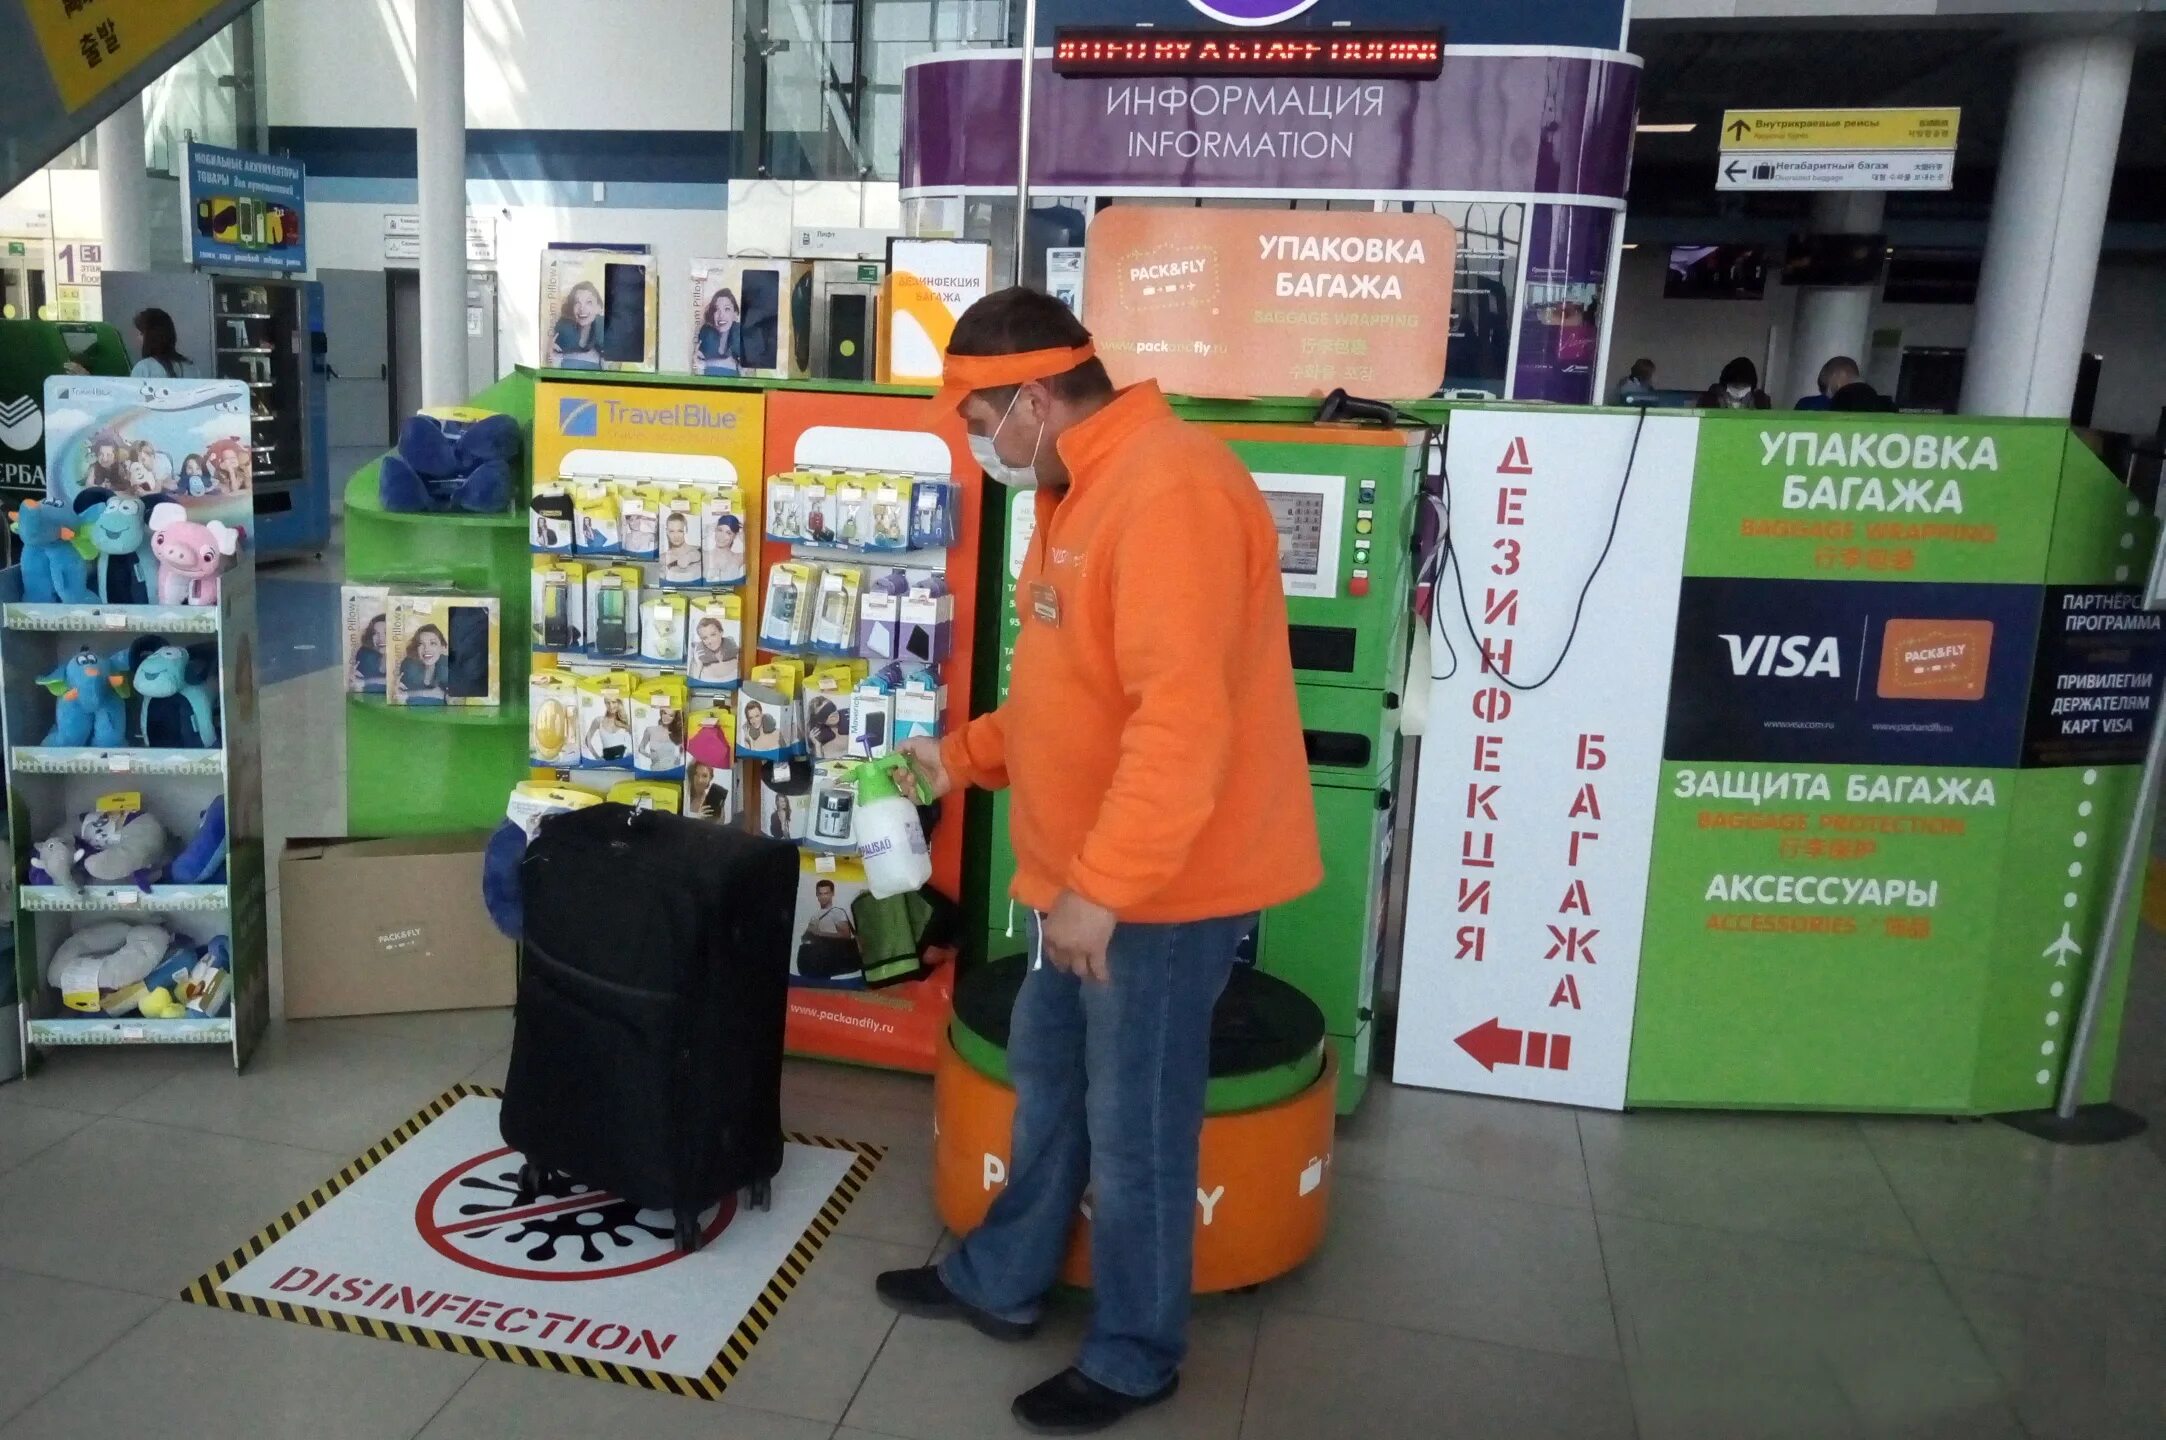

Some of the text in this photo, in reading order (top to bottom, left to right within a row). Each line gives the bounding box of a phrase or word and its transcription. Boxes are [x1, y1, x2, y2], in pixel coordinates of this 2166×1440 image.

[1107, 85, 1384, 119] ИНФОРМАЦИЯ
[1128, 130, 1353, 158] INFORMATION
[1775, 161, 1889, 172] Негабаритный багаж
[59, 244, 74, 284] 1
[1258, 234, 1426, 265] УПАКОВКА
[1129, 258, 1207, 282] PACK&FLY
[1275, 272, 1402, 300] БАГАЖА
[1253, 309, 1419, 328] BAGGAGE WRAPPING
[1759, 431, 1998, 471] УПАКОВКА
[1782, 474, 1964, 514] БАГАЖА
[2065, 615, 2161, 631] ПРОГРАММА
[1717, 633, 1841, 679] VISA
[1904, 644, 1966, 663] PACK&FLY
[2056, 673, 2153, 690] ПРИВИЛЕГИИ
[1453, 437, 1534, 961] ДЕЗИНФЕКЦИЯ
[2050, 696, 2150, 716] ДЕРЖАТЕЛЯМ
[2061, 718, 2133, 734] КАРТ VISA
[1673, 770, 1996, 806] ЗАЩИТА БАГАЖА
[1543, 733, 1609, 1010] БАГАЖА
[1704, 873, 1938, 907] АКСЕССУАРЫ
[378, 928, 421, 943] PACK&FLY
[790, 1003, 894, 1033] www.packandfly.ru
[269, 1265, 679, 1361] DISINFECTION
